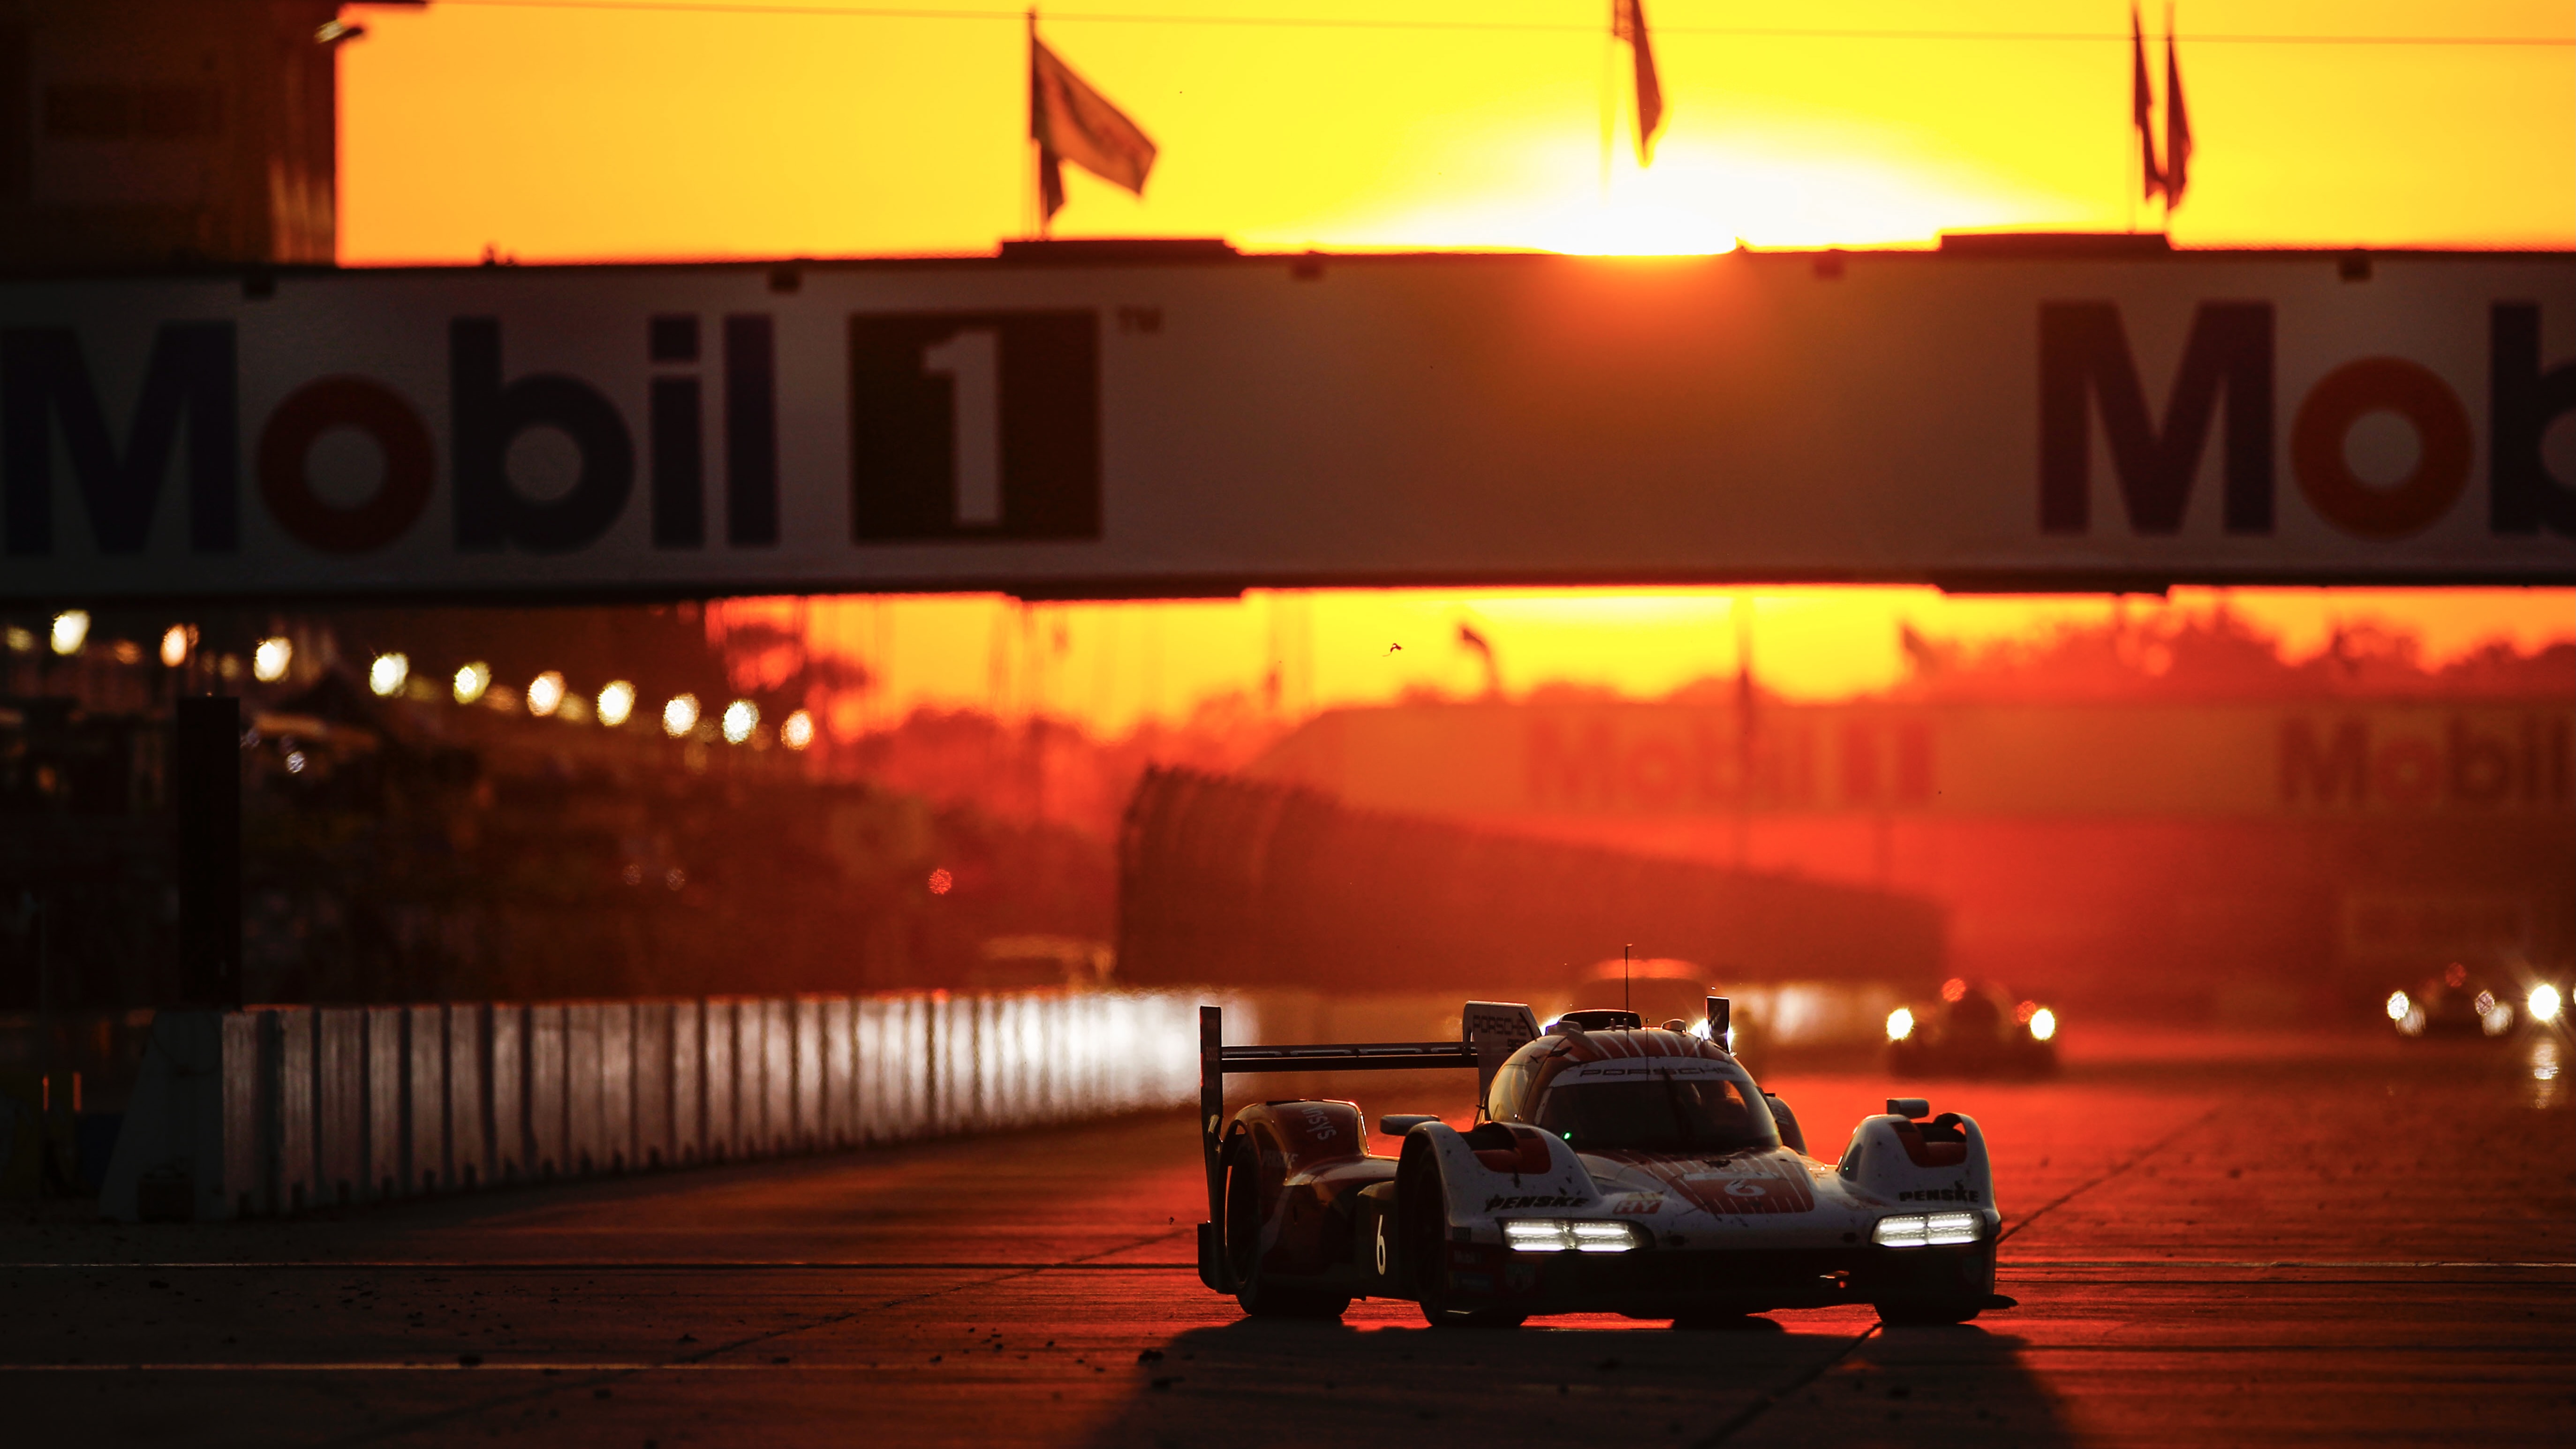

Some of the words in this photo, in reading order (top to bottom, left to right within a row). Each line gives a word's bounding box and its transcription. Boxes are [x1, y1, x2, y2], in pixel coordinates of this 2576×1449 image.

[1, 313, 779, 556] Mobil
[1117, 306, 1162, 333] TM
[1526, 718, 1814, 806] Mobil
[2279, 715, 2571, 808] Mobil
[1473, 1014, 1527, 1036] PORSCHE
[1579, 1066, 1736, 1077] PORSCHE
[1724, 1177, 1766, 1197] 6
[1899, 1189, 1979, 1202] PENSKE
[1485, 1195, 1590, 1212] PENSKE
[1616, 1200, 1657, 1213] HY
[1376, 1214, 1386, 1275] 6
